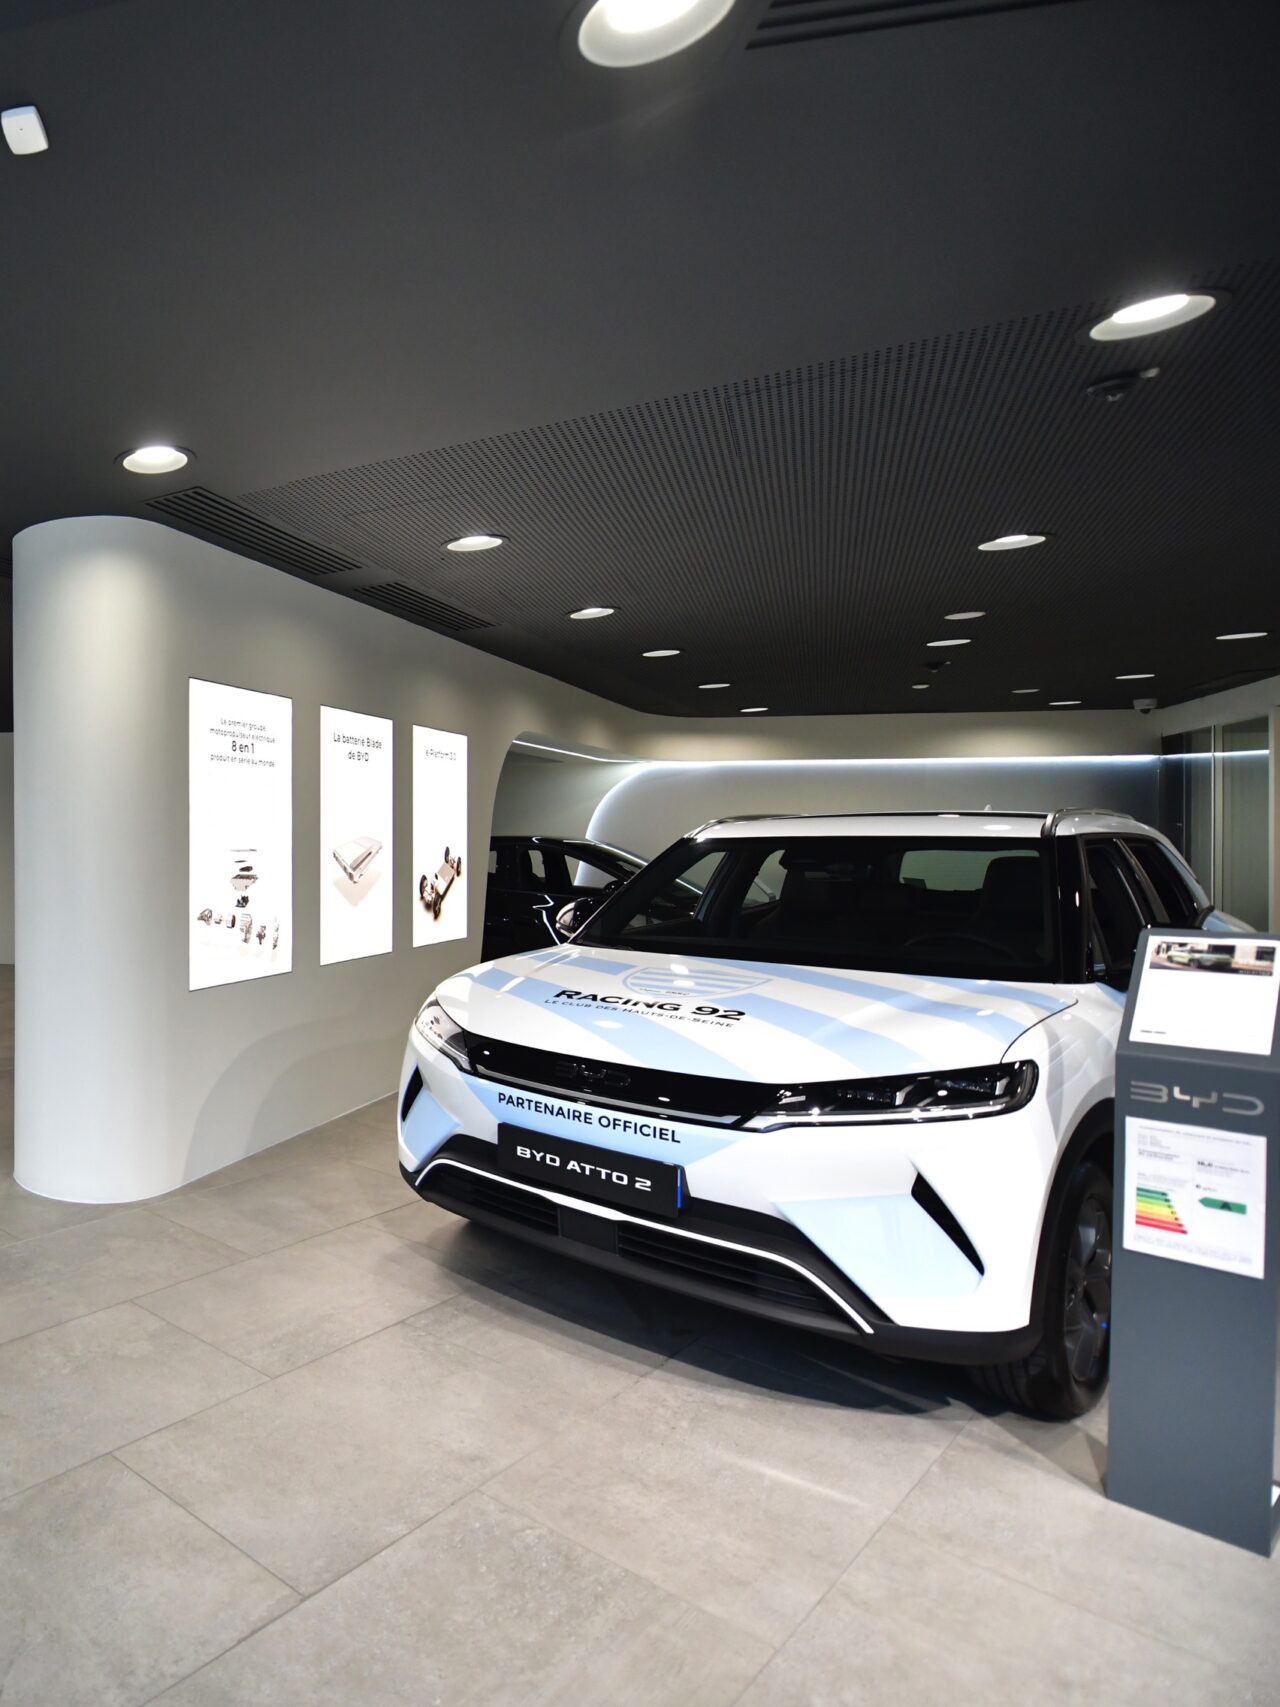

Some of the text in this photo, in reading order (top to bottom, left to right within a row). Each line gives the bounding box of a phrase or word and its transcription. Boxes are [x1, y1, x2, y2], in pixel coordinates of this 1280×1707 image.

[231, 740, 255, 754] 8 en 1
[333, 731, 382, 749] La batterie Blade
[210, 753, 230, 763] produit
[347, 750, 369, 762] de BYD
[553, 989, 746, 1021] RACING 92
[1130, 1080, 1265, 1116] BYD
[498, 1092, 681, 1143] PARTENAIRE OFFICIEL
[516, 1146, 652, 1192] BYD ATTO 2
